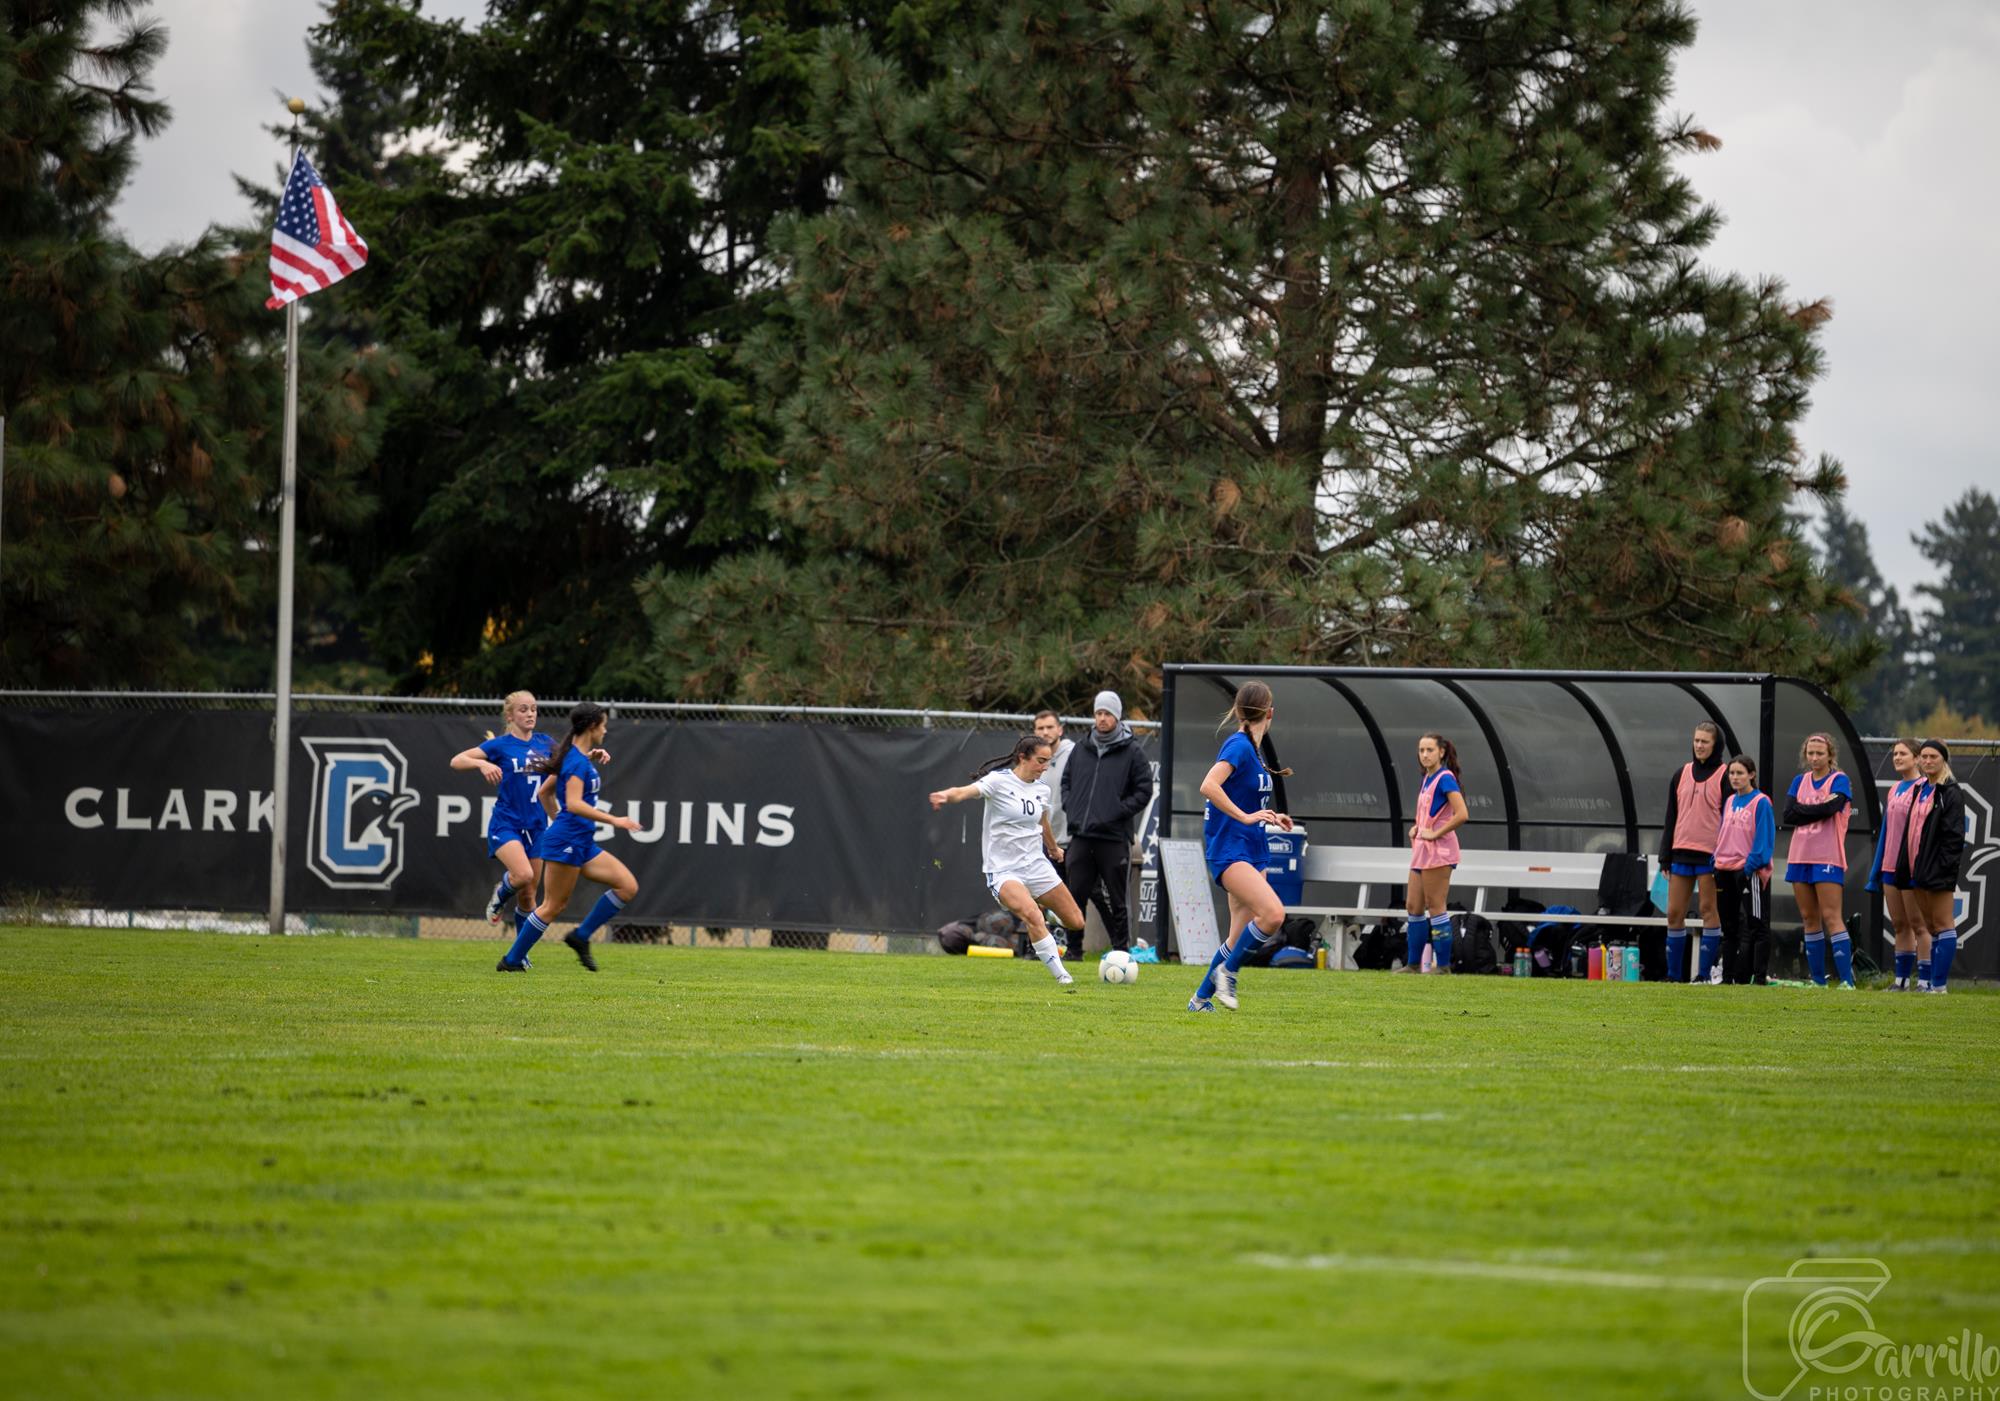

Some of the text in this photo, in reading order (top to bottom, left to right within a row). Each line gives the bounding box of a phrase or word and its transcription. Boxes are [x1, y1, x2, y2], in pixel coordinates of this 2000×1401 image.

[527, 775, 541, 803] 7
[64, 787, 275, 832] CLARK
[1021, 798, 1035, 816] 10
